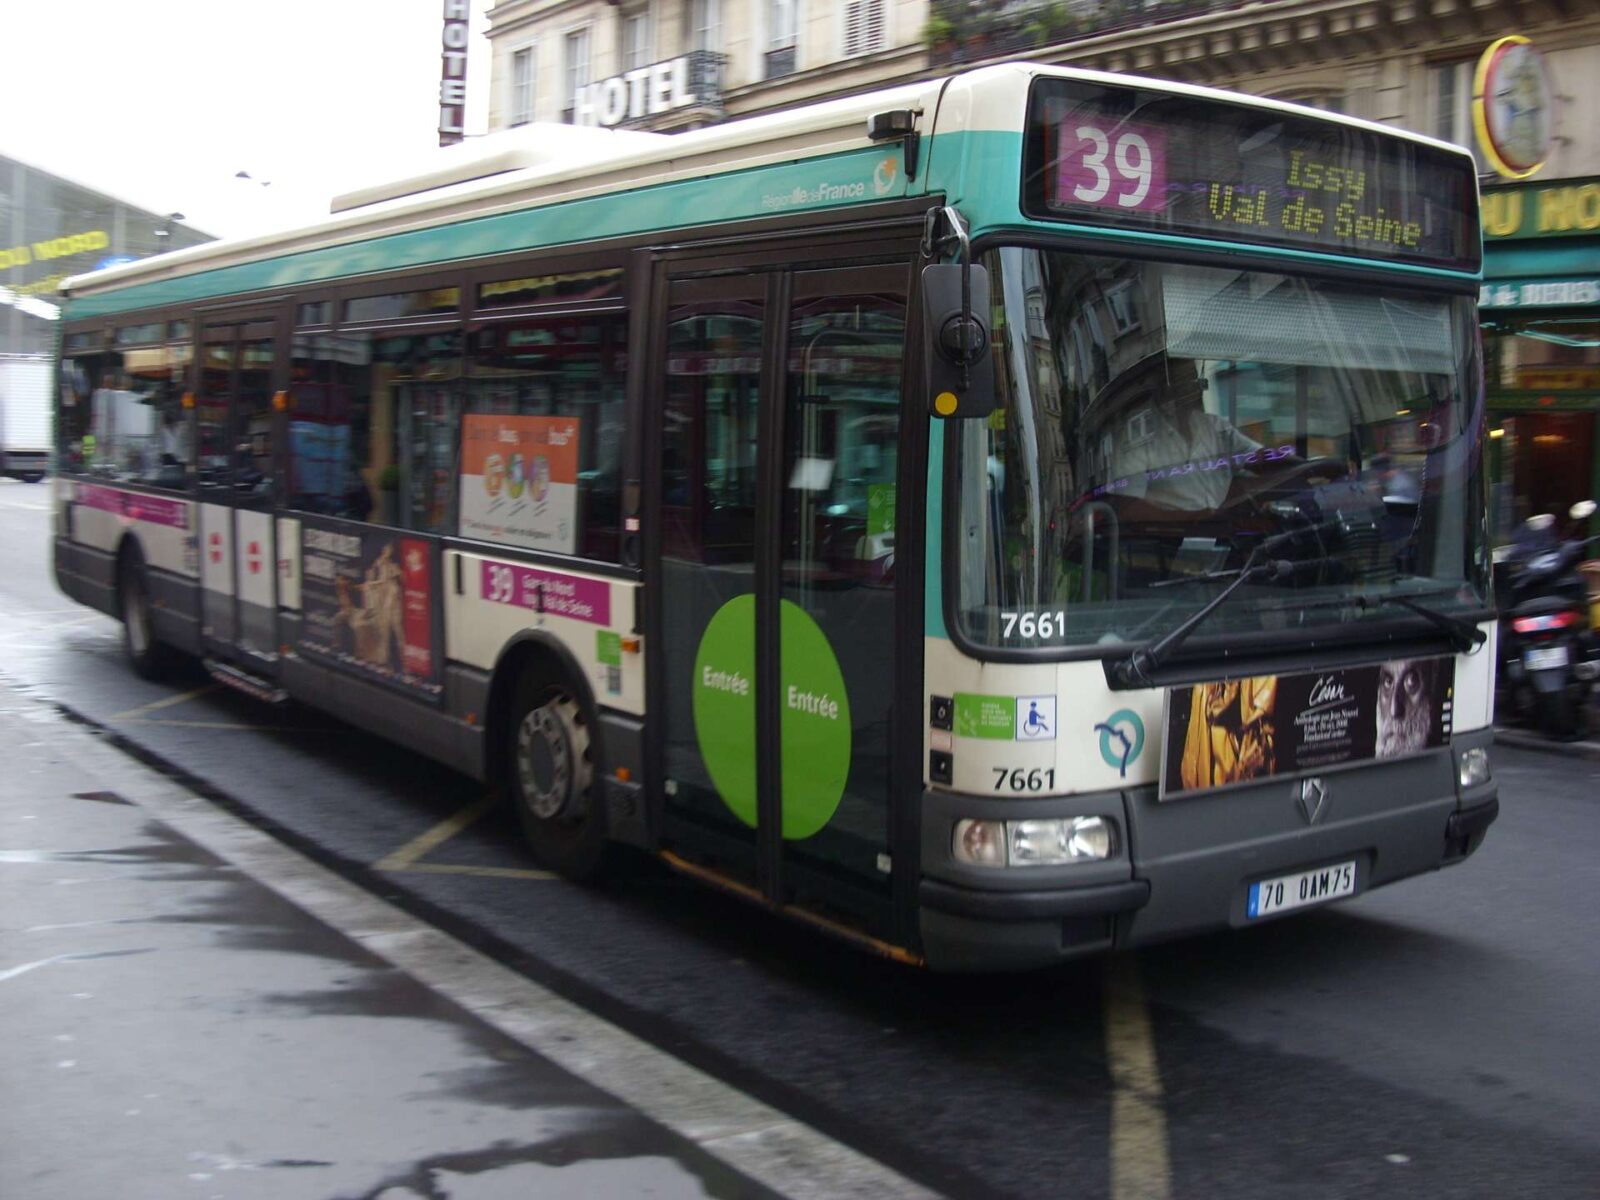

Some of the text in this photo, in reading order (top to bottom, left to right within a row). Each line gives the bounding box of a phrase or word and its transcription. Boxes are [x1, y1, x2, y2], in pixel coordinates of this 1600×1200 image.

[439, 0, 470, 134] HOTEL
[575, 57, 695, 127] HOTEL
[1072, 126, 1153, 208] 39
[1286, 149, 1366, 201] Issy
[820, 182, 865, 201] France
[1208, 182, 1423, 247] Val de Seine
[488, 565, 514, 602] 39
[1000, 610, 1065, 639] 7661
[703, 665, 749, 697] Entrée
[787, 685, 838, 720] Entrée
[992, 767, 1056, 792] 7661
[1264, 883, 1284, 909] 70
